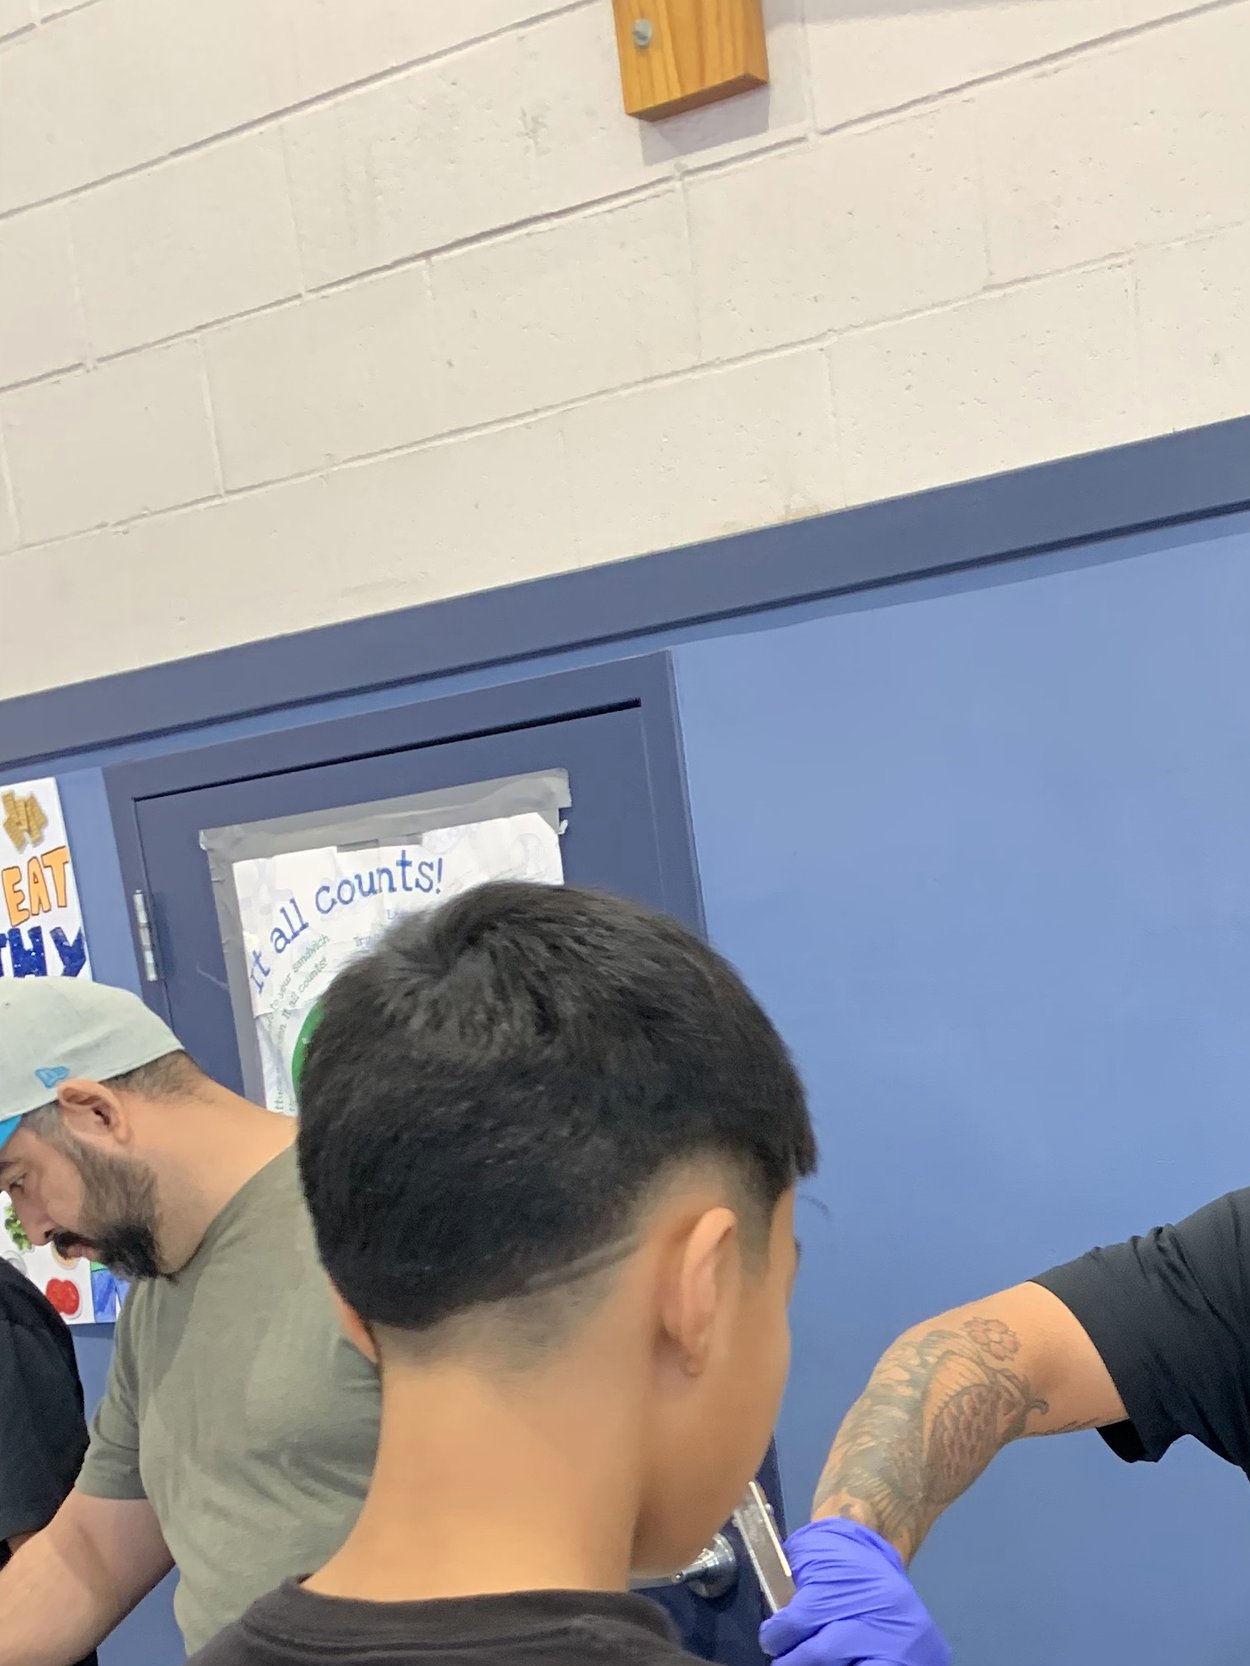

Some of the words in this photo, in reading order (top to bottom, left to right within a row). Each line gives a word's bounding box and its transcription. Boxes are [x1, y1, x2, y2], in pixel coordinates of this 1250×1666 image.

[2, 845, 69, 927] EAT
[270, 898, 309, 954] all
[315, 850, 443, 914] counts!
